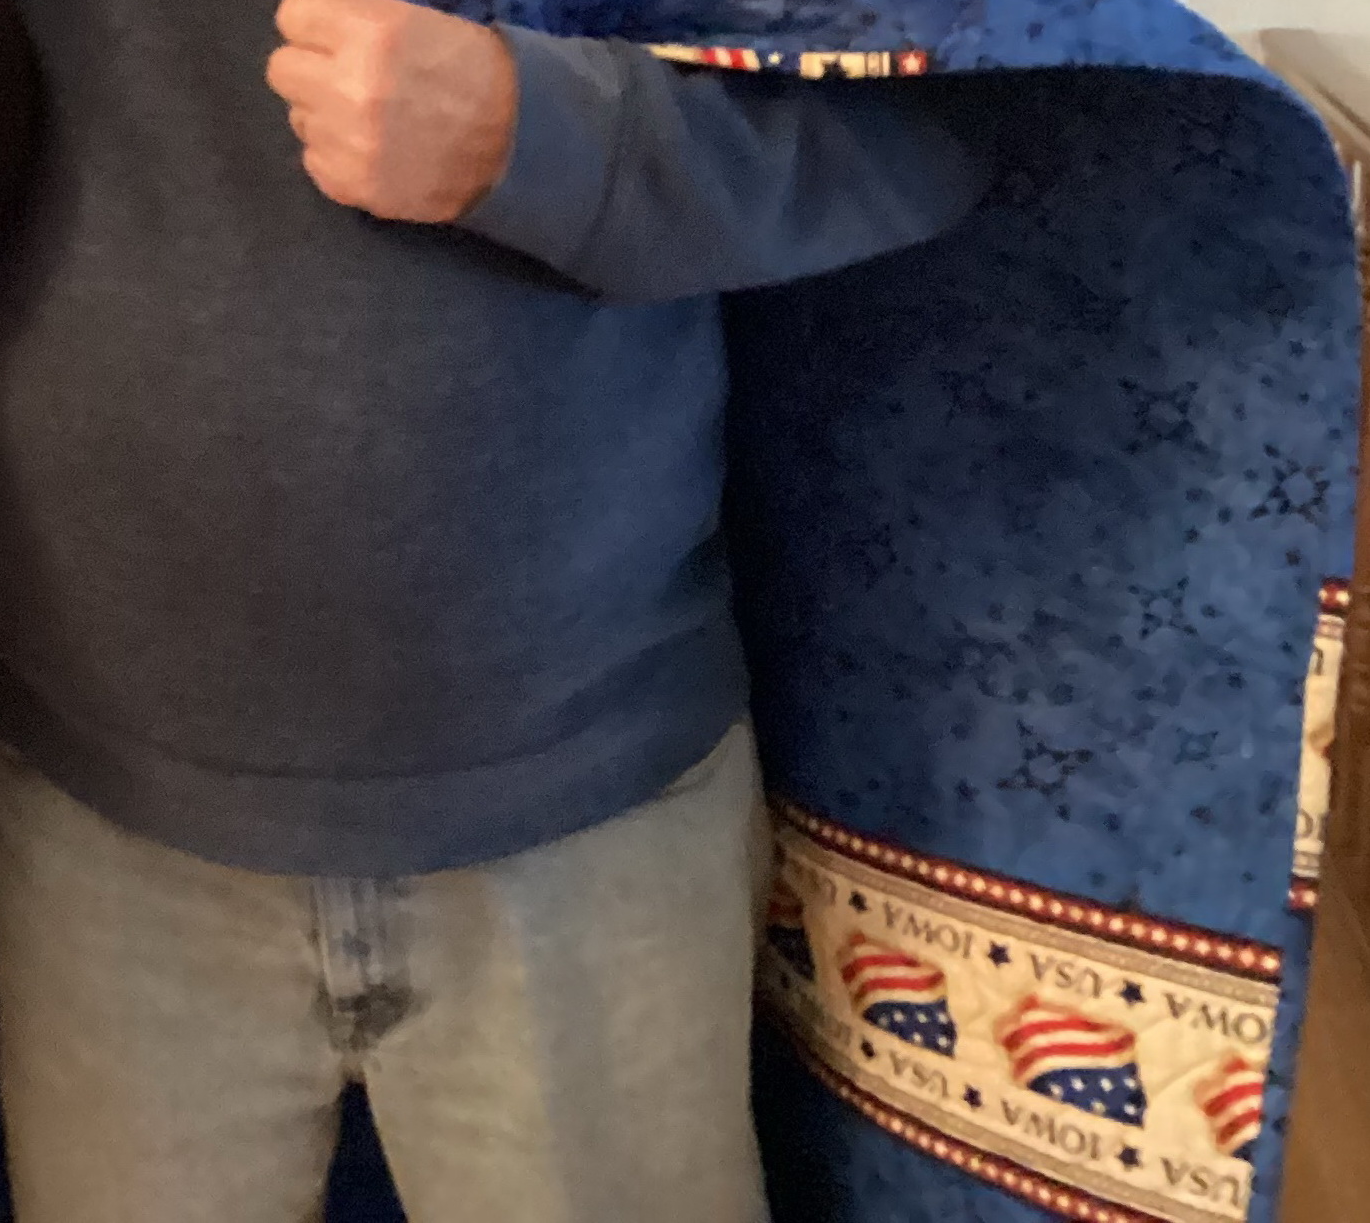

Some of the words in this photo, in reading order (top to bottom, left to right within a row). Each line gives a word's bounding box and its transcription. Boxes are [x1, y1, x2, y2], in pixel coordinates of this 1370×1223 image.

[883, 900, 974, 959] IOWA
[1030, 952, 1102, 999] USA
[889, 1049, 950, 1098] USA
[1000, 1098, 1101, 1160] IOWA
[1160, 1156, 1240, 1206] USA
